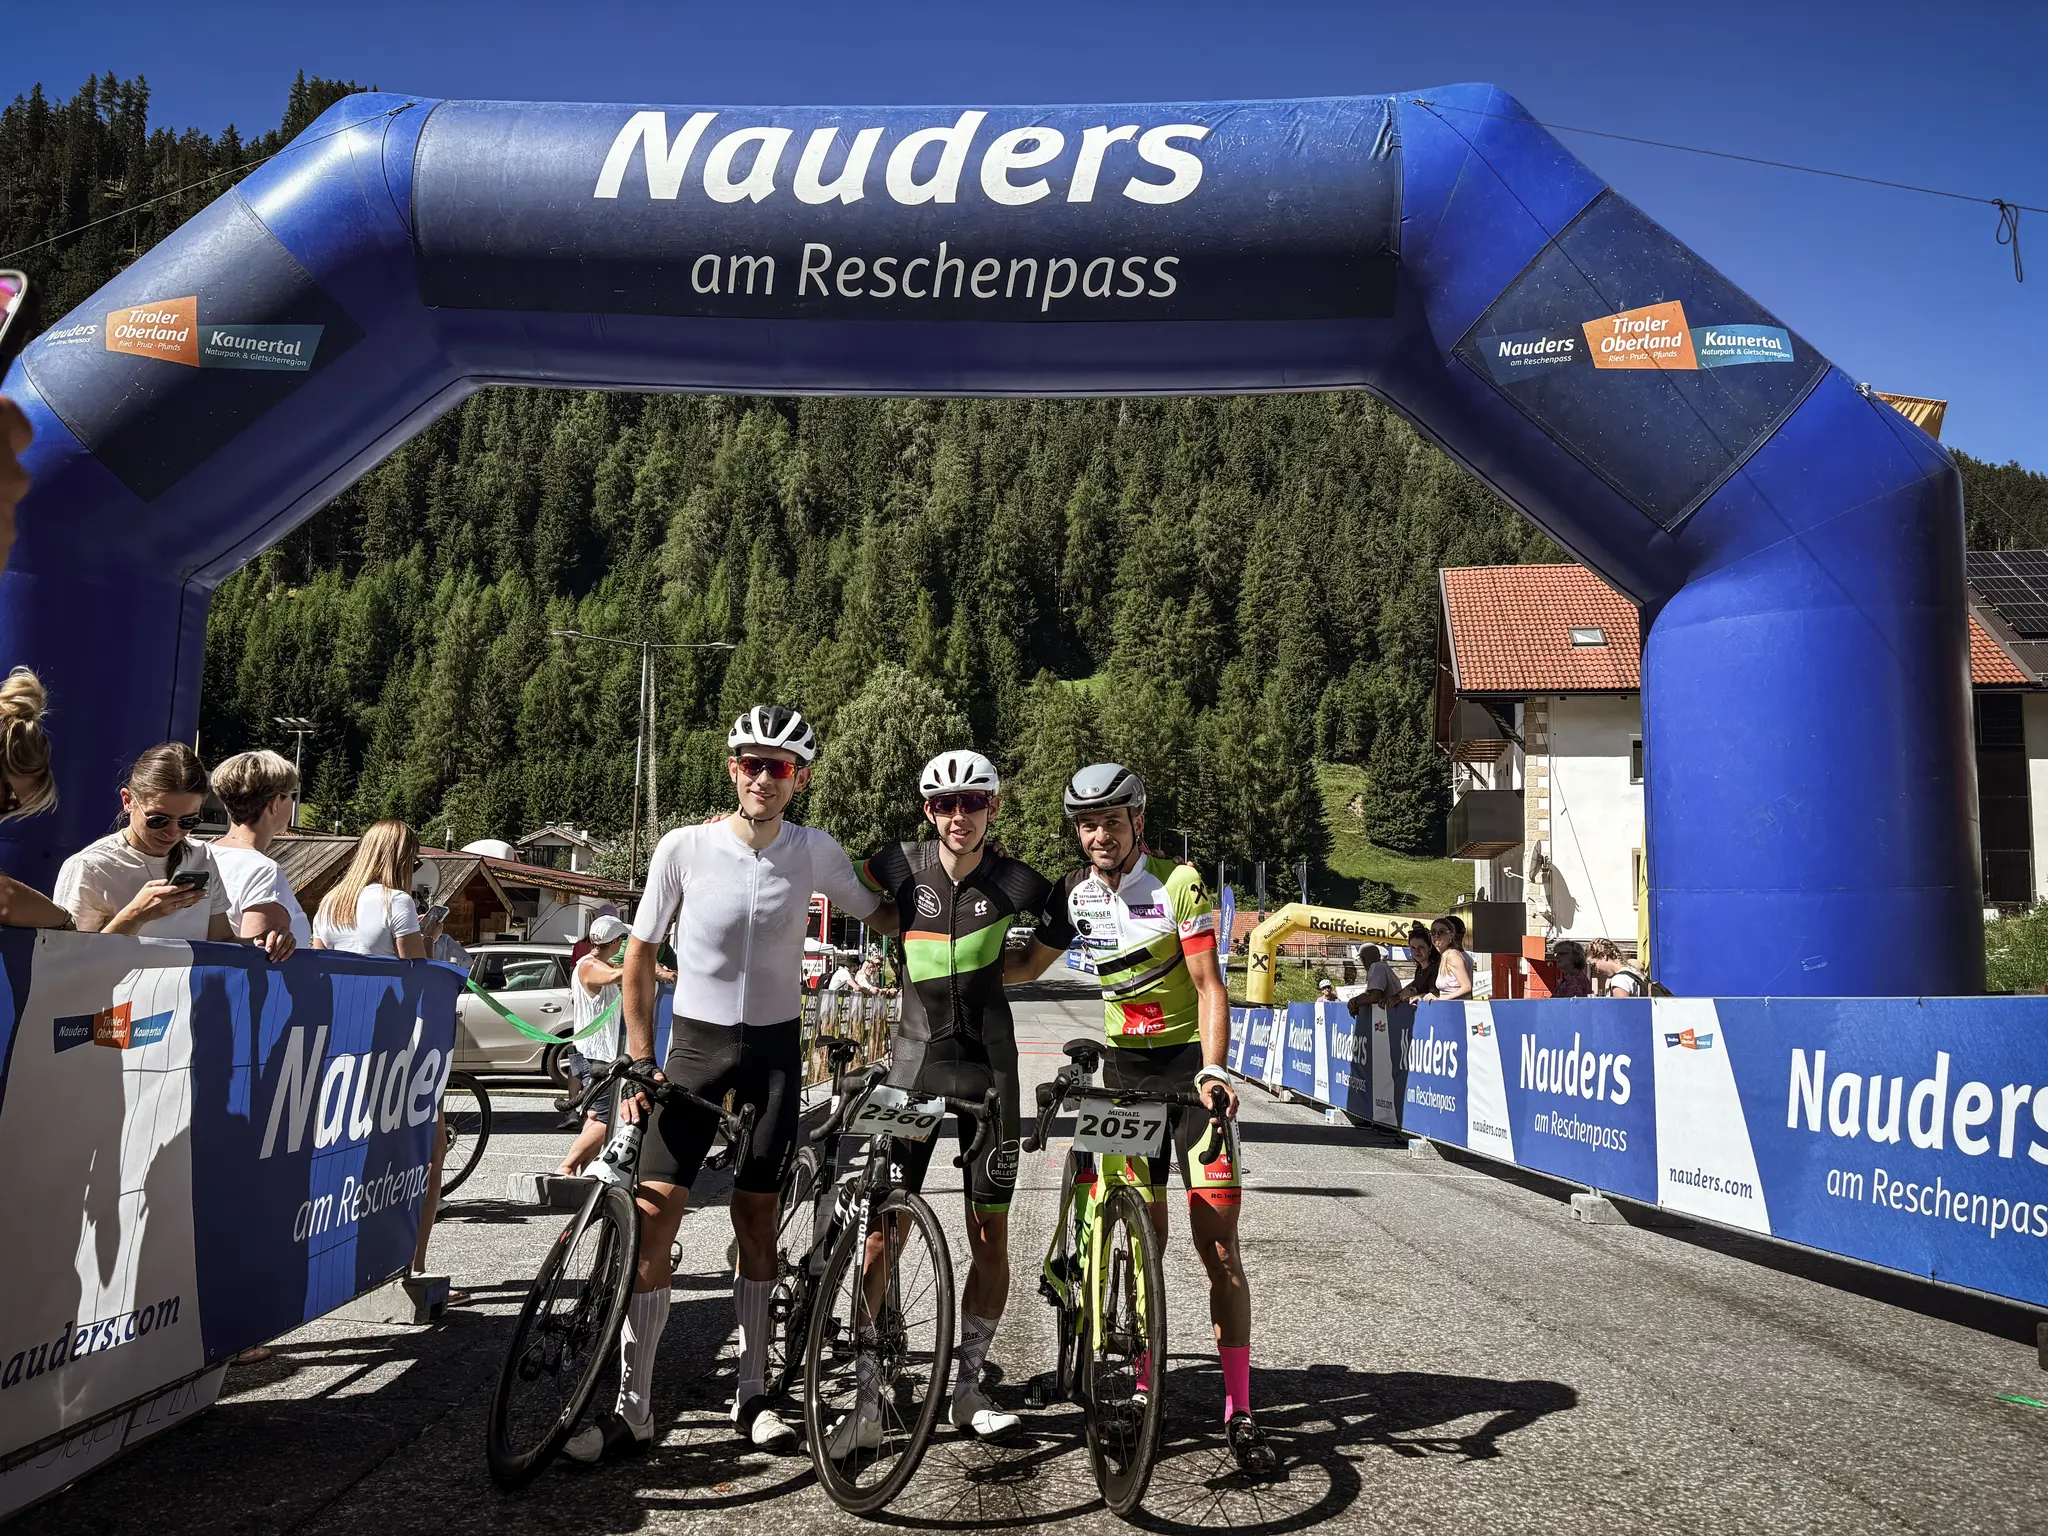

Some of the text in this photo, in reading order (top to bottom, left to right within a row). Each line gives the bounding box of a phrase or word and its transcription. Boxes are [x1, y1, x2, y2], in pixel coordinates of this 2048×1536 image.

[592, 110, 1211, 206] Nauders
[691, 240, 1180, 312] am Reschenpass
[128, 309, 179, 324] Tiroler
[1612, 316, 1669, 334] Tiroler
[45, 324, 98, 342] Nauders
[114, 325, 189, 343] Oberland
[1600, 331, 1682, 353] Oberland
[1704, 331, 1782, 350] Kaunertal
[211, 331, 301, 357] Kaunertal
[1498, 335, 1574, 358] Nauders
[1701, 348, 1735, 358] Naturpark
[204, 347, 241, 360] Naturpark
[250, 353, 307, 368] Gletscherregion
[1510, 354, 1572, 367] am Reschenpass
[1608, 352, 1625, 362] Ried
[1653, 350, 1678, 362] Pfunds
[1263, 922, 1287, 940] Raiffeisen
[1309, 916, 1386, 938] Raiffeisen
[59, 1025, 89, 1037] Nauders
[103, 1016, 124, 1027] Tiroler
[133, 1026, 164, 1038] Kaunertal
[96, 1028, 127, 1039] Oberland
[1331, 1022, 1368, 1066] Nauders
[1400, 1025, 1458, 1078] Nauders
[1519, 1032, 1632, 1106] Nauders
[895, 1102, 918, 1112] PASCAL
[1407, 1085, 1456, 1114] am Reschenpass
[860, 1103, 937, 1129] 2360
[1107, 1109, 1140, 1118] MICHAEL
[1079, 1114, 1162, 1142] 2057
[1472, 1119, 1507, 1140] nauders.com
[1534, 1110, 1628, 1154] am Reschenpass
[1207, 1171, 1232, 1179] TIWAG
[1669, 1166, 1753, 1200] nauders.com
[1826, 1168, 1863, 1201] am
[293, 1193, 333, 1243] am
[858, 1191, 871, 1241] FACTOR
[0, 1295, 181, 1390] auders.com
